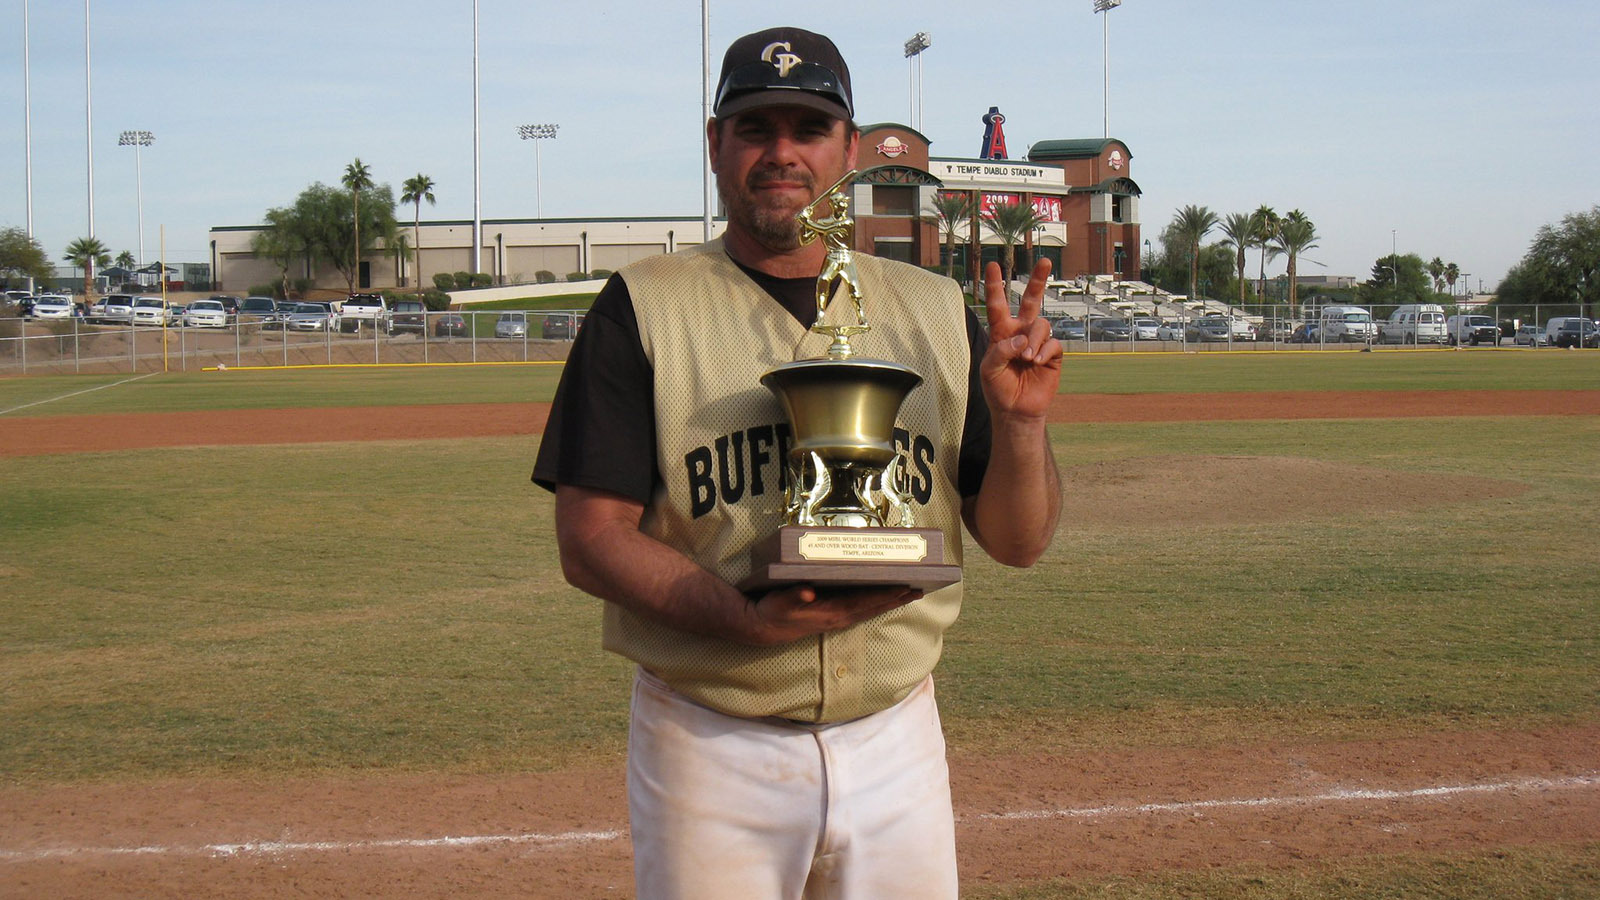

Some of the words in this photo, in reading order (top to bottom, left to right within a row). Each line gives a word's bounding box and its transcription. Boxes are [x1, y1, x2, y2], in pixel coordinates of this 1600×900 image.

[956, 165, 981, 174] TEMPE
[984, 166, 1008, 176] DIABLO
[1011, 168, 1037, 177] STADIUM
[985, 194, 1009, 204] 2009
